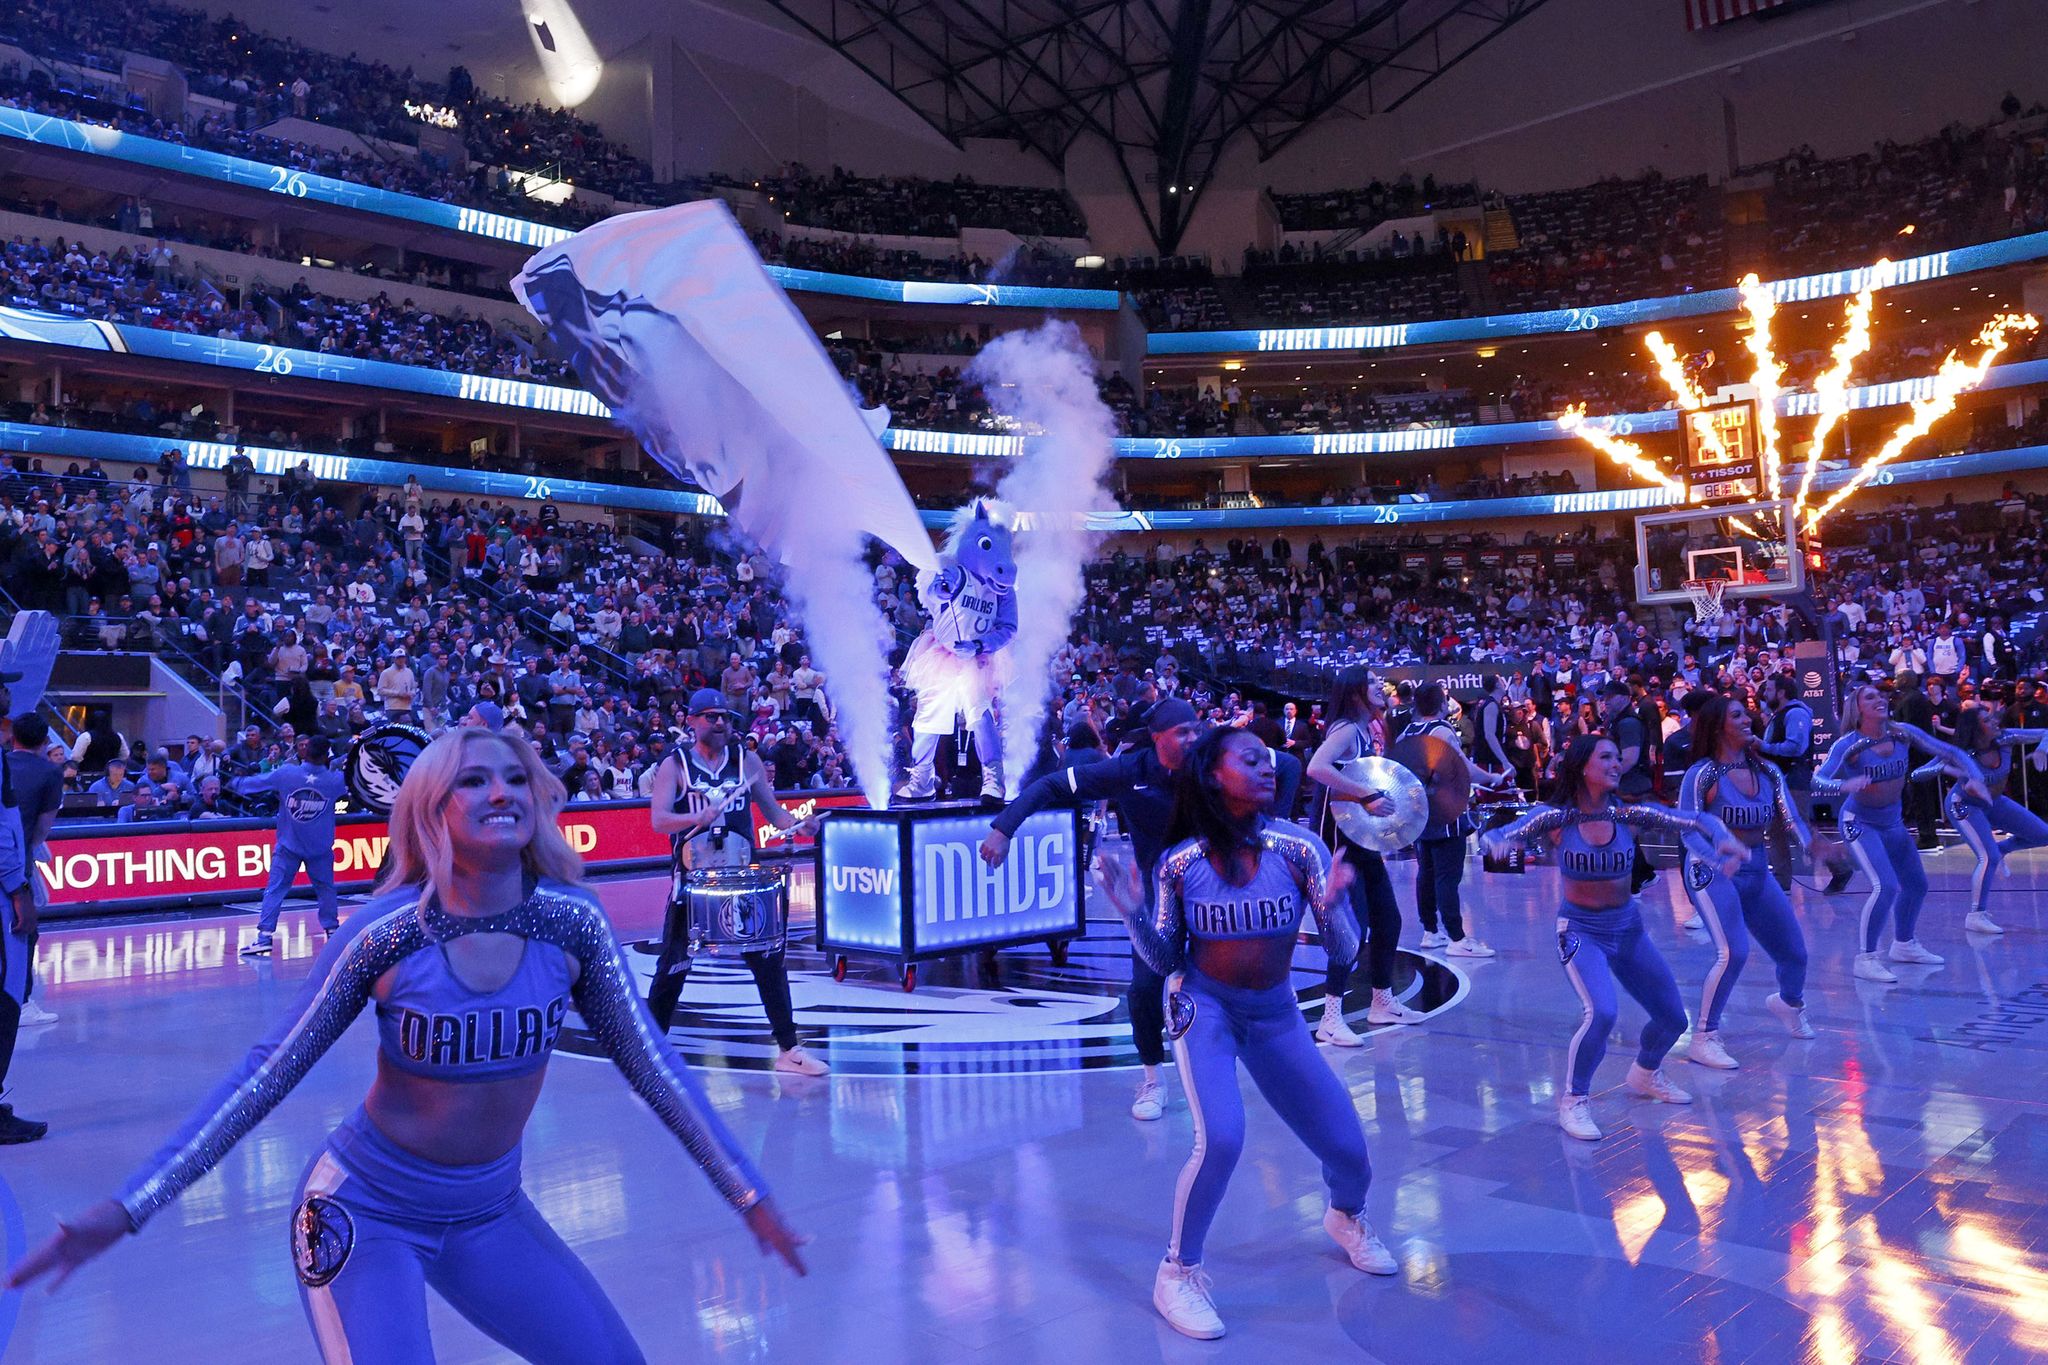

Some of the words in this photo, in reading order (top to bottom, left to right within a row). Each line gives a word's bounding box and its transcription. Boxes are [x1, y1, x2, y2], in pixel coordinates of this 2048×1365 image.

[269, 166, 307, 197] 26
[1564, 308, 1599, 331] 26
[255, 344, 293, 375] 26
[1154, 438, 1181, 458] 26
[1707, 464, 1752, 478] TISSOT
[524, 476, 551, 500] 26
[1374, 505, 1399, 523] 26
[961, 594, 994, 615] DALLAS
[1803, 689, 1824, 698] AT&T
[35, 847, 226, 890] NOTHING
[832, 865, 894, 896] UTSW
[924, 832, 1066, 925] MAVS
[1193, 893, 1296, 934] DALLAS
[401, 994, 564, 1067] DALLAS
